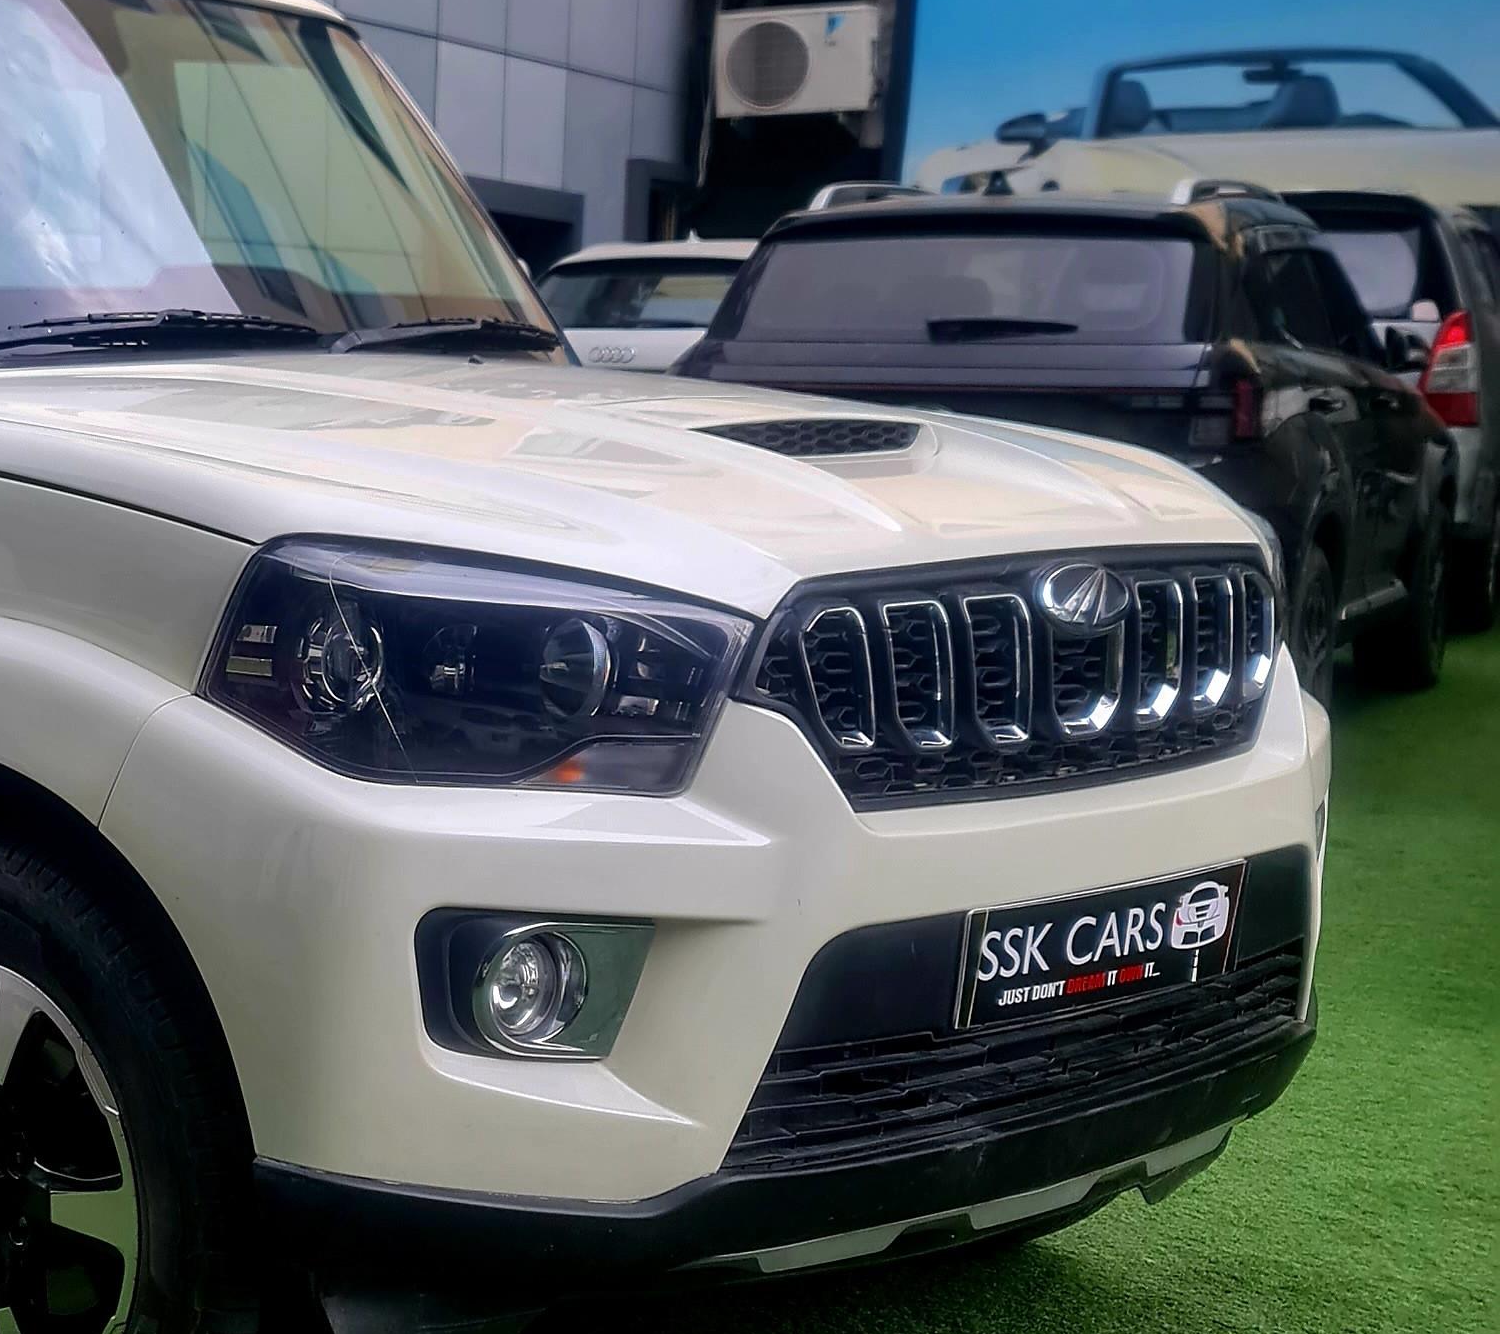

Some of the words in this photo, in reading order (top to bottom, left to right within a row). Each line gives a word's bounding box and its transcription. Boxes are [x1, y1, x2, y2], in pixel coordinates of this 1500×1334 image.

[977, 922, 1053, 981] SSK
[1066, 902, 1167, 965] CARS
[998, 986, 1031, 1006] JUST
[1031, 980, 1066, 1001] DON'T
[1106, 970, 1118, 987] IT
